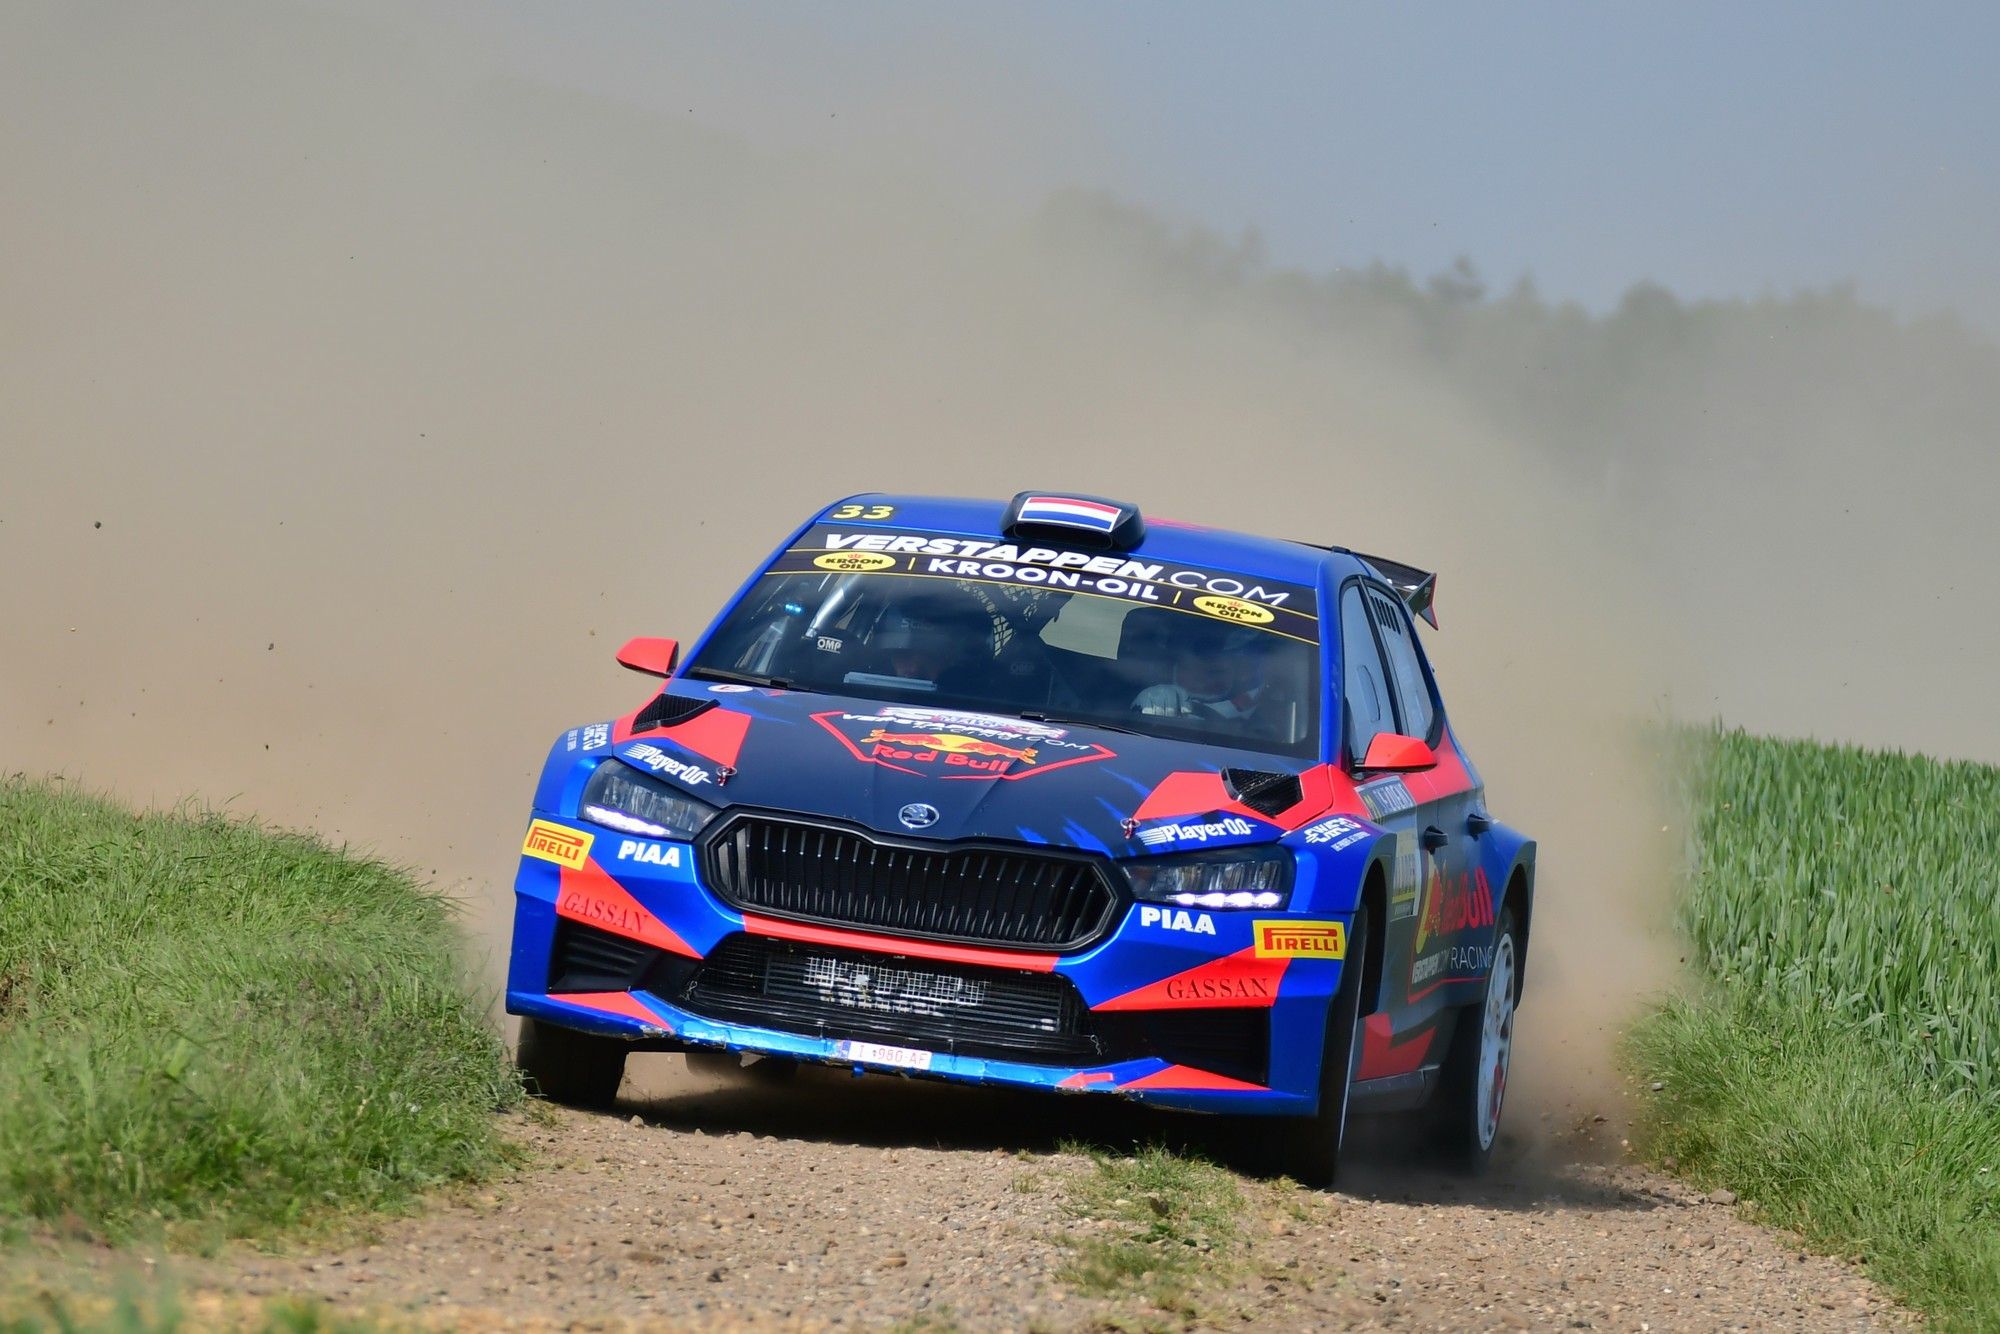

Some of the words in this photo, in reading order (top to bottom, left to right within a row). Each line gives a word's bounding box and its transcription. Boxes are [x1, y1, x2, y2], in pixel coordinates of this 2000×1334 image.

[833, 505, 894, 519] 33
[825, 557, 883, 565] KROON
[825, 533, 1290, 606] VERSTAPPEN.COM
[928, 558, 1159, 600] KROON-OIL
[1205, 600, 1262, 618] KROON
[1218, 610, 1243, 620] OIL
[818, 638, 842, 651] OMP
[872, 744, 937, 762] Red
[945, 752, 1011, 772] Bull
[526, 827, 584, 861] PIRELLI
[618, 840, 681, 868] PIAA
[563, 892, 647, 934] GASSAN
[1141, 907, 1216, 935] PIAA
[1264, 927, 1338, 952] PIRELLI
[1166, 977, 1268, 1001] GASSAN
